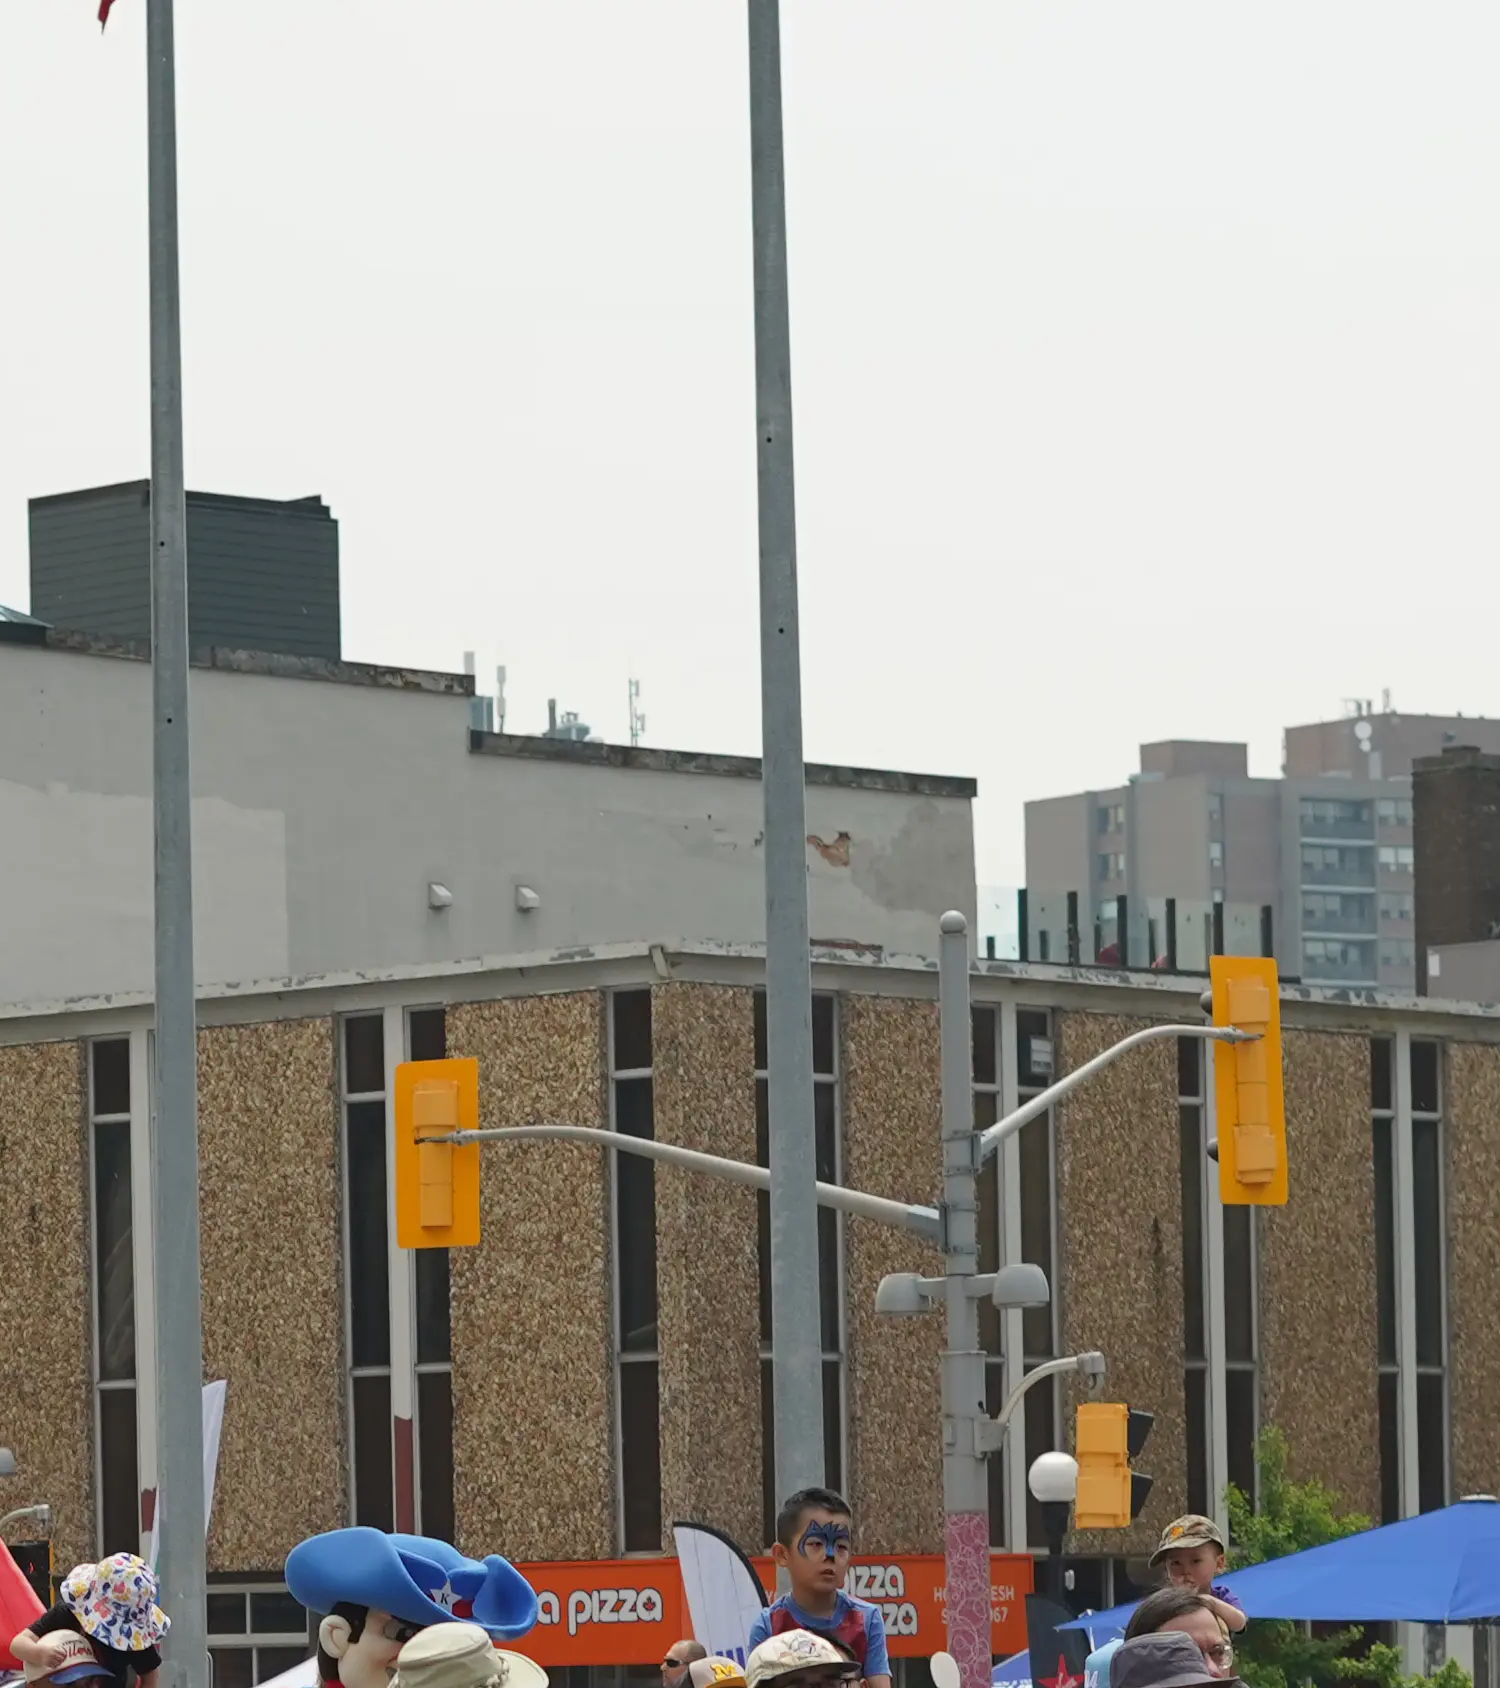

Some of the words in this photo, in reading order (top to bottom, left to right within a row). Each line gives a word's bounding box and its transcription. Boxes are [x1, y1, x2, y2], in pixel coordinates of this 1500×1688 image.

[843, 1565, 904, 1598] izza
[440, 1591, 450, 1605] K
[567, 1588, 663, 1636] pizza
[711, 1663, 738, 1682] M
